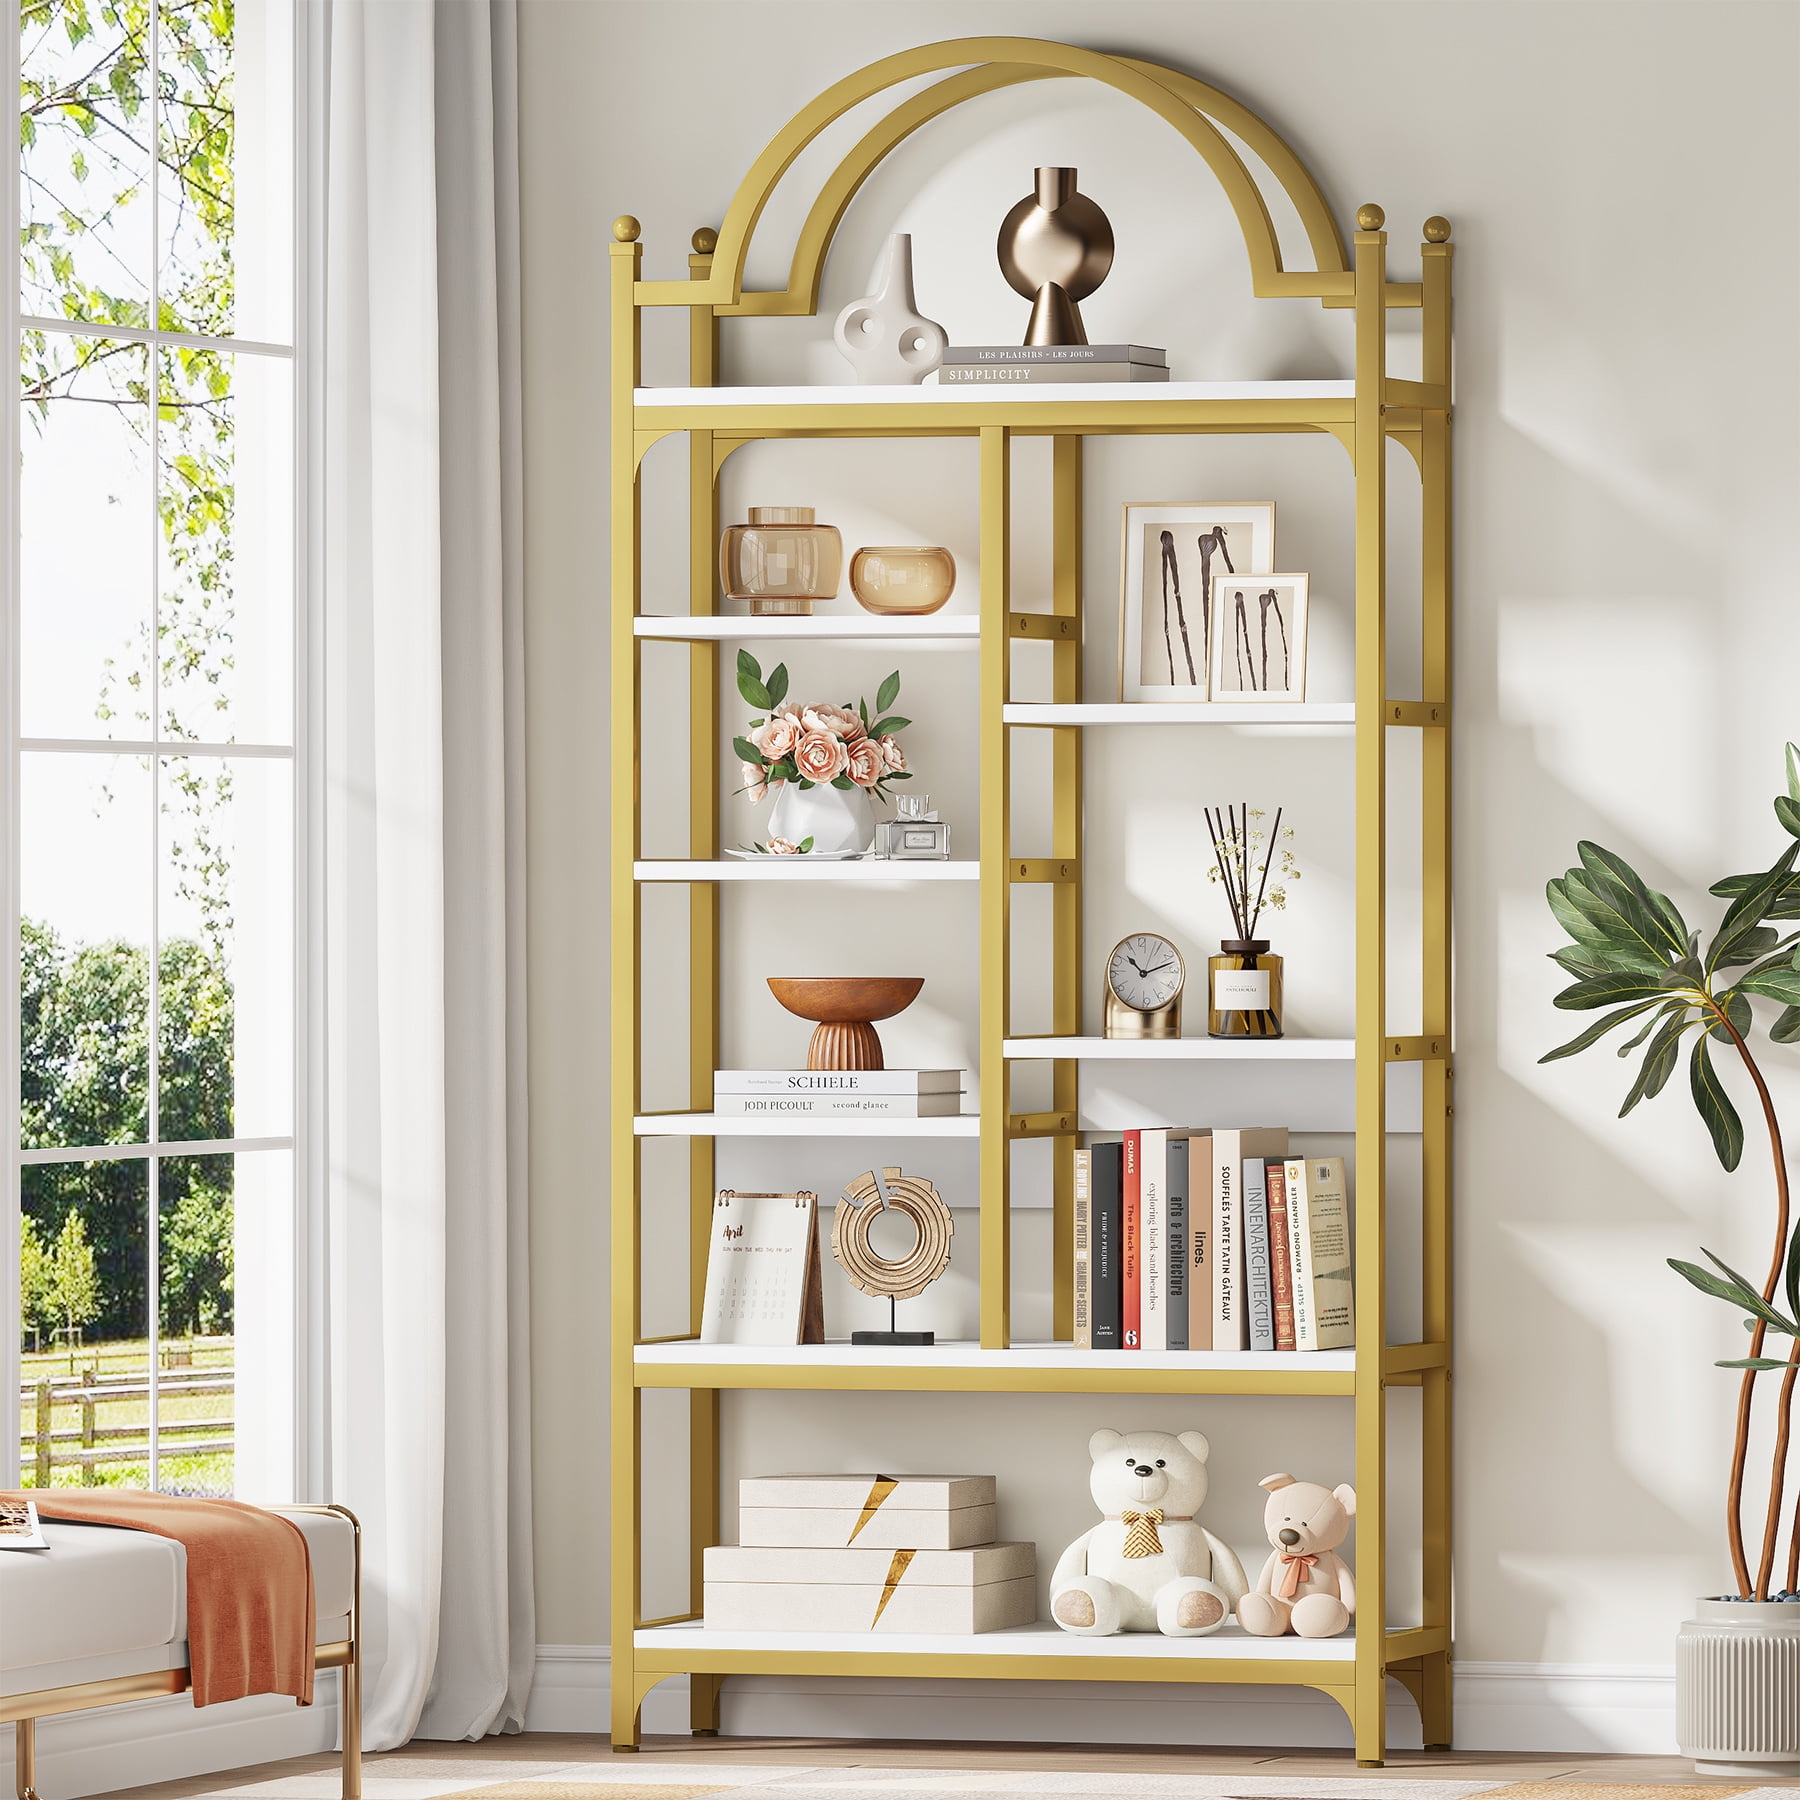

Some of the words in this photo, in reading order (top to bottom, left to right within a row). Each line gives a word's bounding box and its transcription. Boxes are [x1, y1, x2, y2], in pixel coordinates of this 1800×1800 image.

[979, 351, 996, 360] LES
[1000, 351, 1043, 359] PLAISIRS
[1052, 351, 1067, 359] LES
[949, 369, 1031, 381] SIMPLICITY
[788, 1077, 859, 1089] SCHIELE
[744, 1101, 767, 1112] JODI
[770, 1101, 815, 1111] PICOULT
[832, 1101, 860, 1109] second
[863, 1101, 889, 1110] glance
[1221, 1166, 1232, 1212] SOUFFLÉS
[1076, 1201, 1088, 1223] HARRY
[1147, 1183, 1158, 1225] exploring
[1170, 1197, 1183, 1217] arts
[1291, 1187, 1299, 1229] CHANDLER
[722, 1224, 744, 1241] April
[1076, 1225, 1088, 1249] POTTER
[1150, 1228, 1158, 1252] black
[1221, 1215, 1231, 1244] TARTE
[1194, 1231, 1206, 1268] lines.
[1221, 1246, 1231, 1274] TATIN
[1247, 1187, 1270, 1339] INNENARCHITEKTUR
[1076, 1262, 1088, 1293] CHAMBER
[1150, 1254, 1158, 1274] sand
[1170, 1234, 1185, 1296] architecture
[1150, 1275, 1158, 1311] beaches
[1221, 1277, 1233, 1321] GÂTEAUX
[1297, 1284, 1305, 1306] SLEEP
[1076, 1300, 1088, 1328] SECRETS
